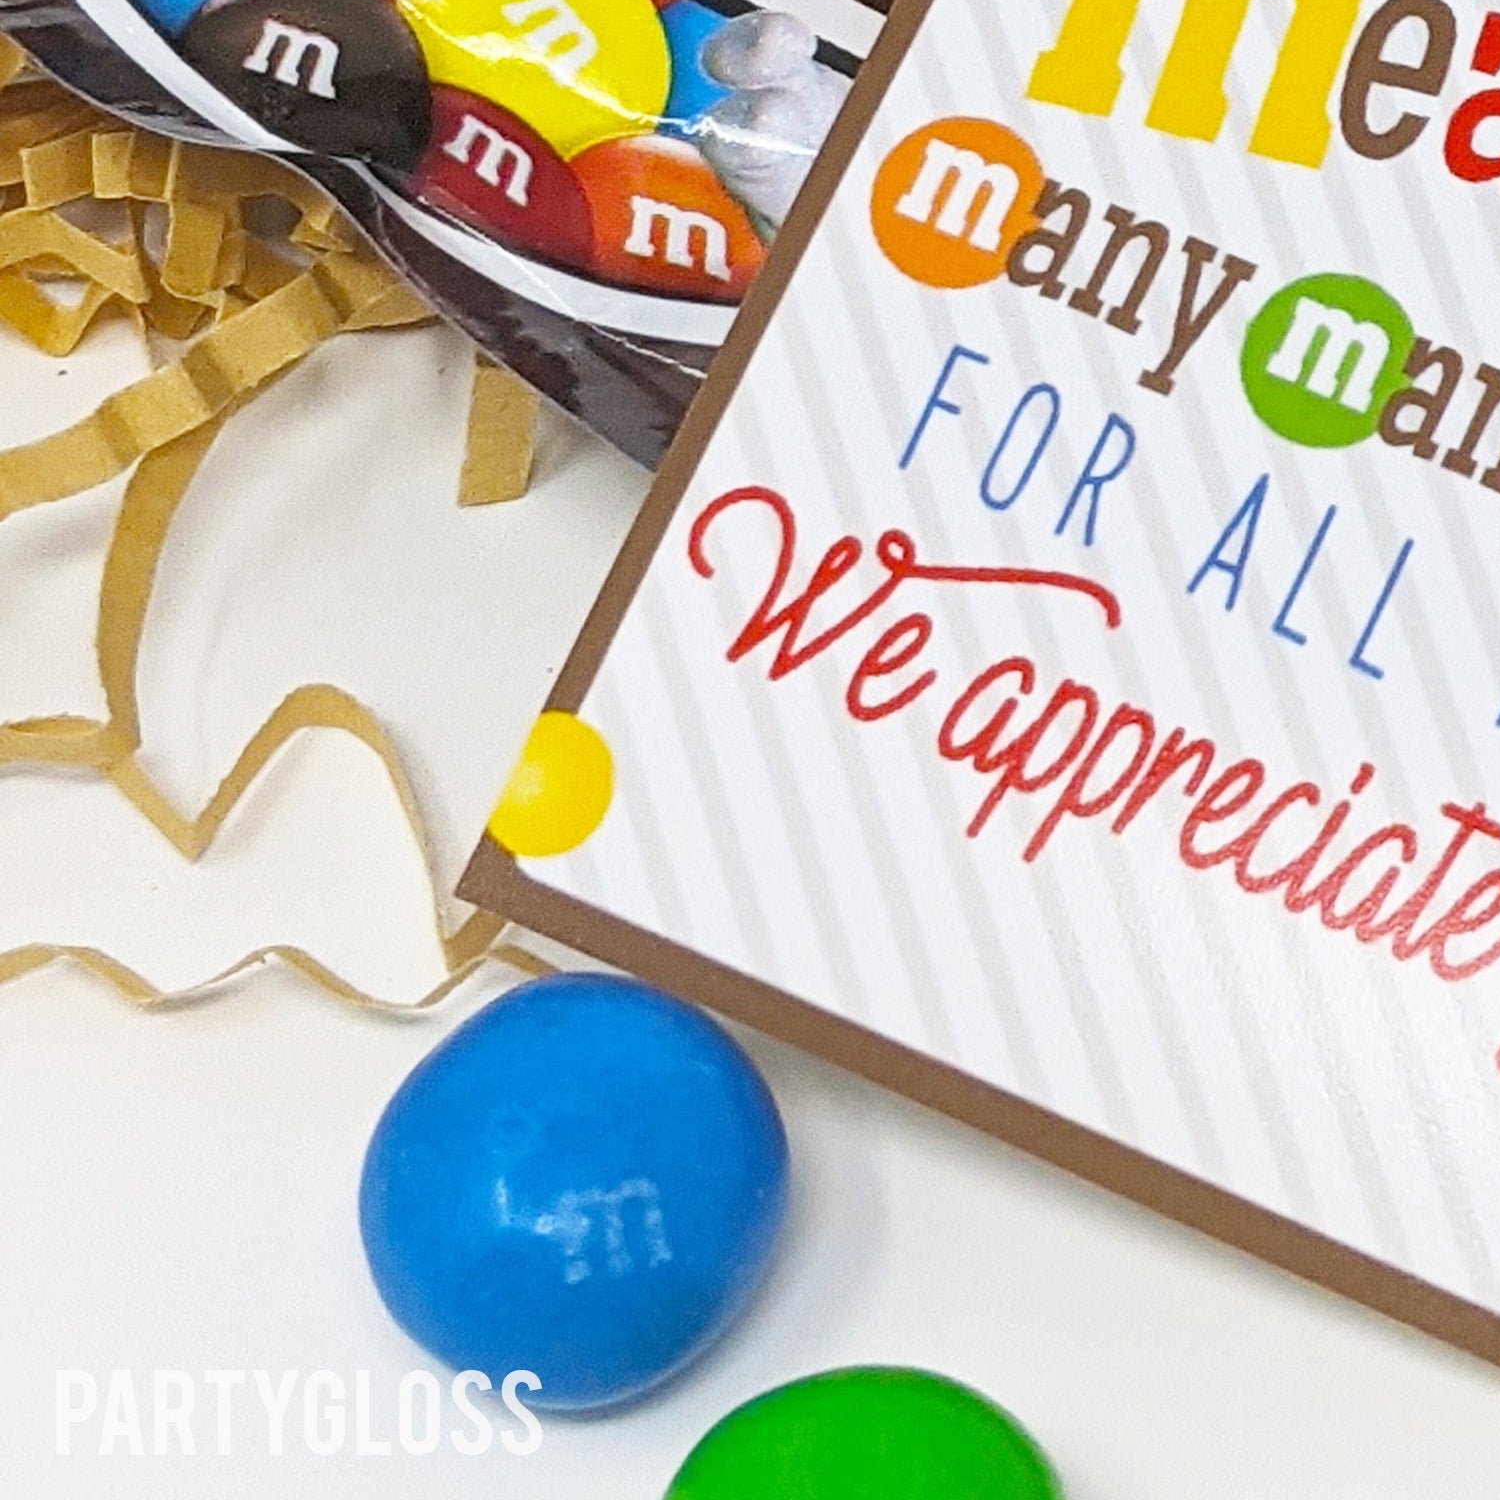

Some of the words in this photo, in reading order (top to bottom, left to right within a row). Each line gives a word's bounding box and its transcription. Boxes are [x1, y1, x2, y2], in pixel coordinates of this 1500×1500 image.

[242, 15, 342, 99] m
[441, 113, 534, 206] m
[624, 193, 732, 282] m
[893, 138, 1258, 396] many
[899, 343, 1137, 548] FOR
[1185, 472, 1415, 682] ALL
[687, 485, 1121, 722] We
